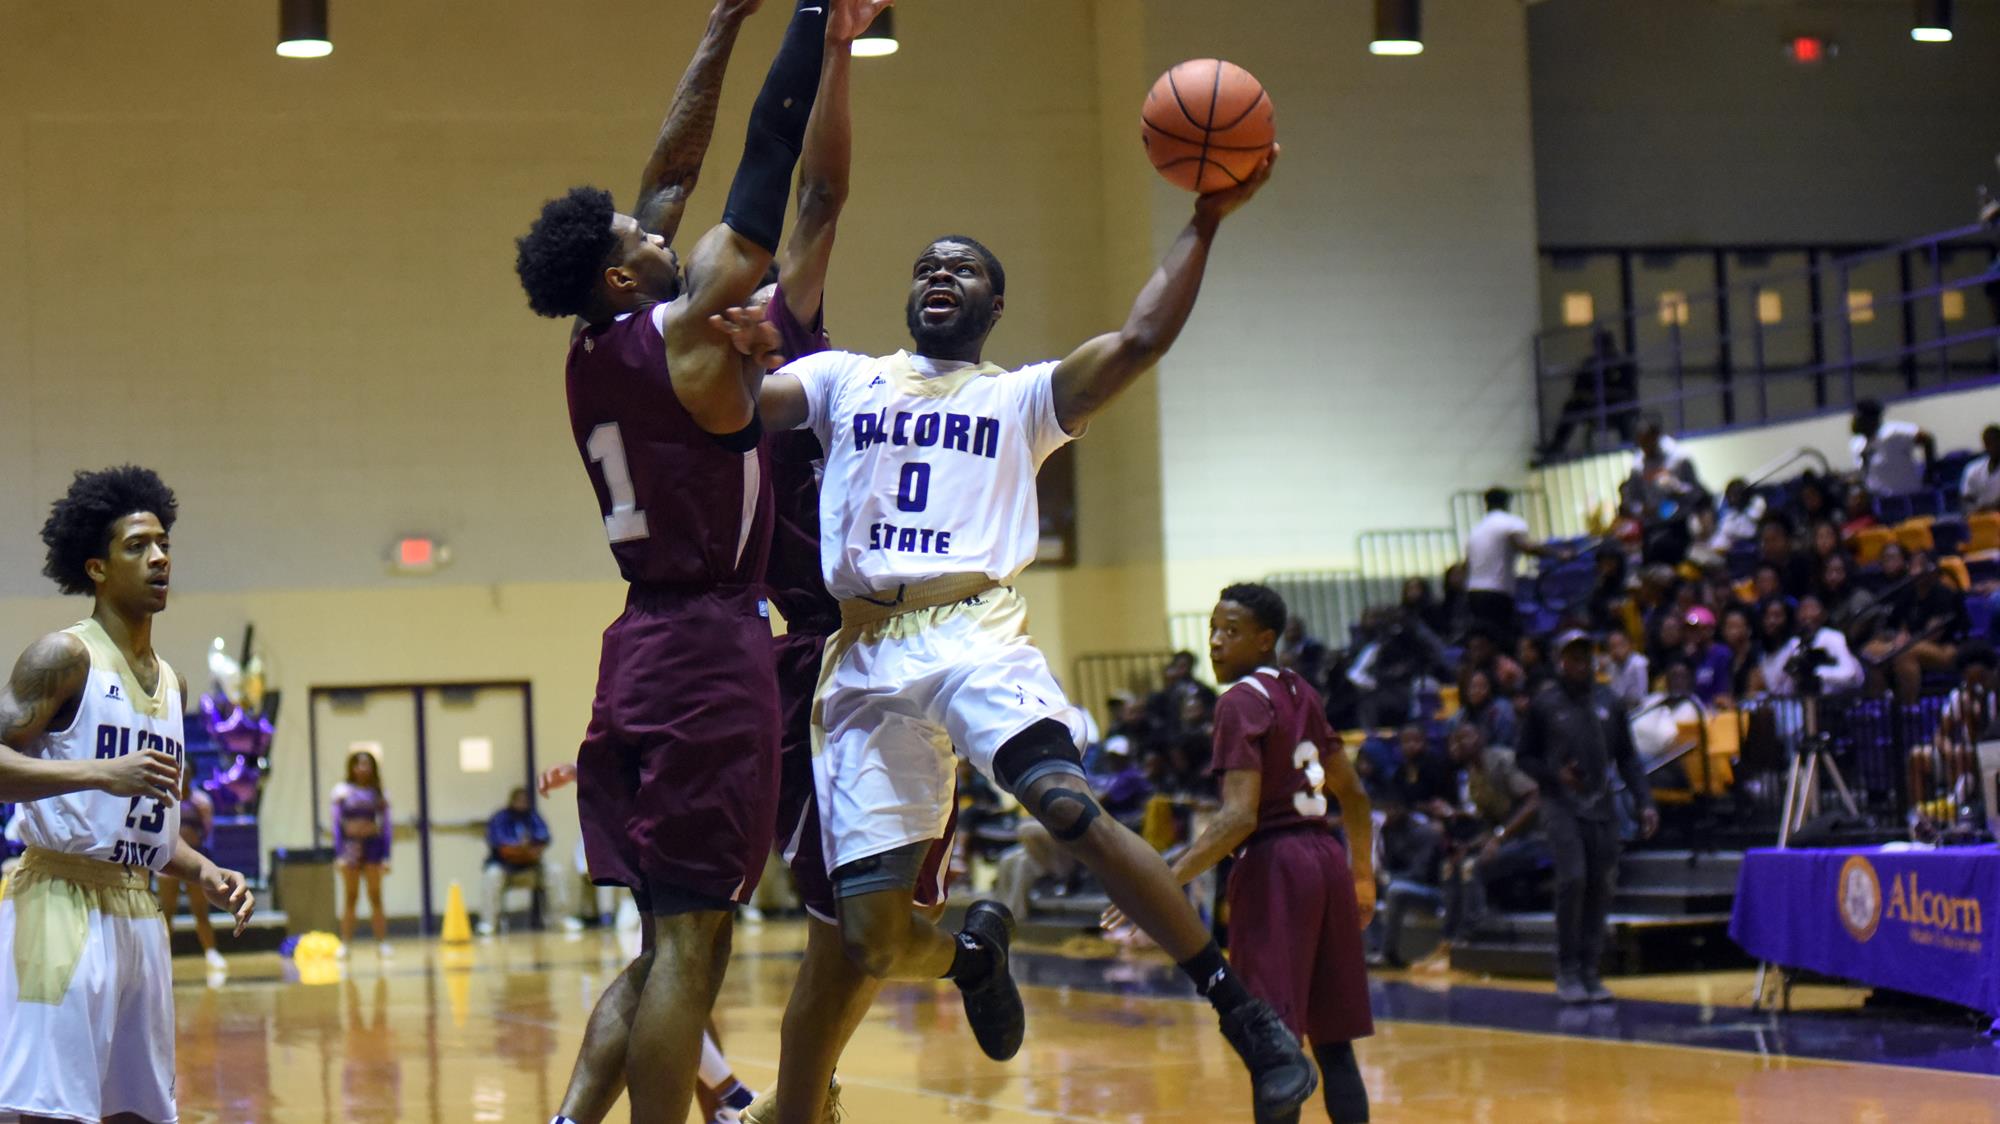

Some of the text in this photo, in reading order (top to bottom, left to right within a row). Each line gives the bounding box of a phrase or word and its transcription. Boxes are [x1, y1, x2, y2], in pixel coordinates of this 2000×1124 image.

[854, 407, 1000, 458] ALCORN
[586, 421, 650, 544] 1
[897, 462, 931, 512] 0
[870, 523, 951, 554] STATE
[1293, 741, 1328, 816] 3
[1886, 871, 1982, 934] Alcorn
